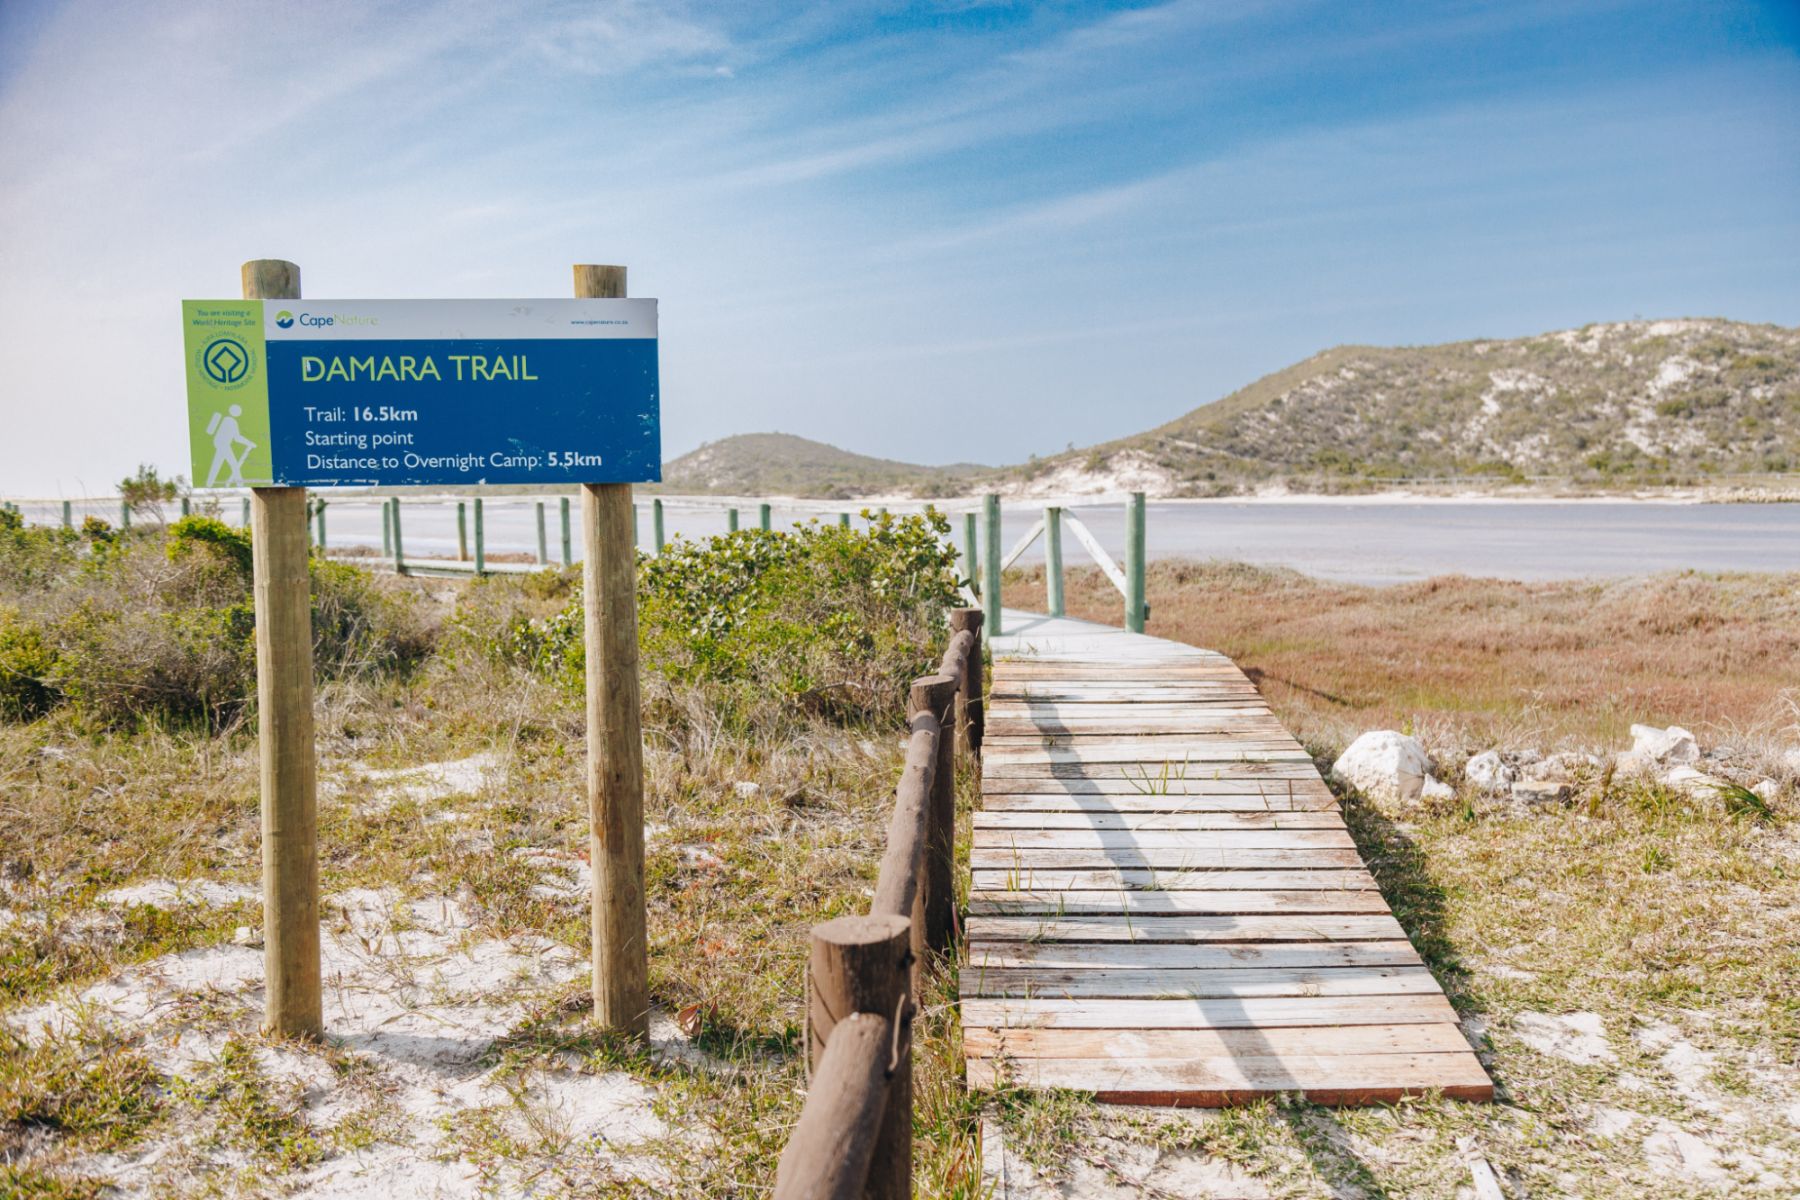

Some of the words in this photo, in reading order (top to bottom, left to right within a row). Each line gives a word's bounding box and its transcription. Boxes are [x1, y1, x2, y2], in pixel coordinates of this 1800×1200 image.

[301, 355, 442, 382] DAMARA
[447, 354, 539, 381] TRAIL
[303, 406, 346, 422] Trail:
[353, 405, 418, 422] 16.5km
[305, 430, 368, 450] Starting
[372, 431, 414, 449] point
[307, 453, 378, 470] Distance
[381, 456, 399, 469] to
[403, 452, 486, 472] Overnight
[489, 452, 543, 470] Camp:
[547, 451, 602, 468] 5.5km
